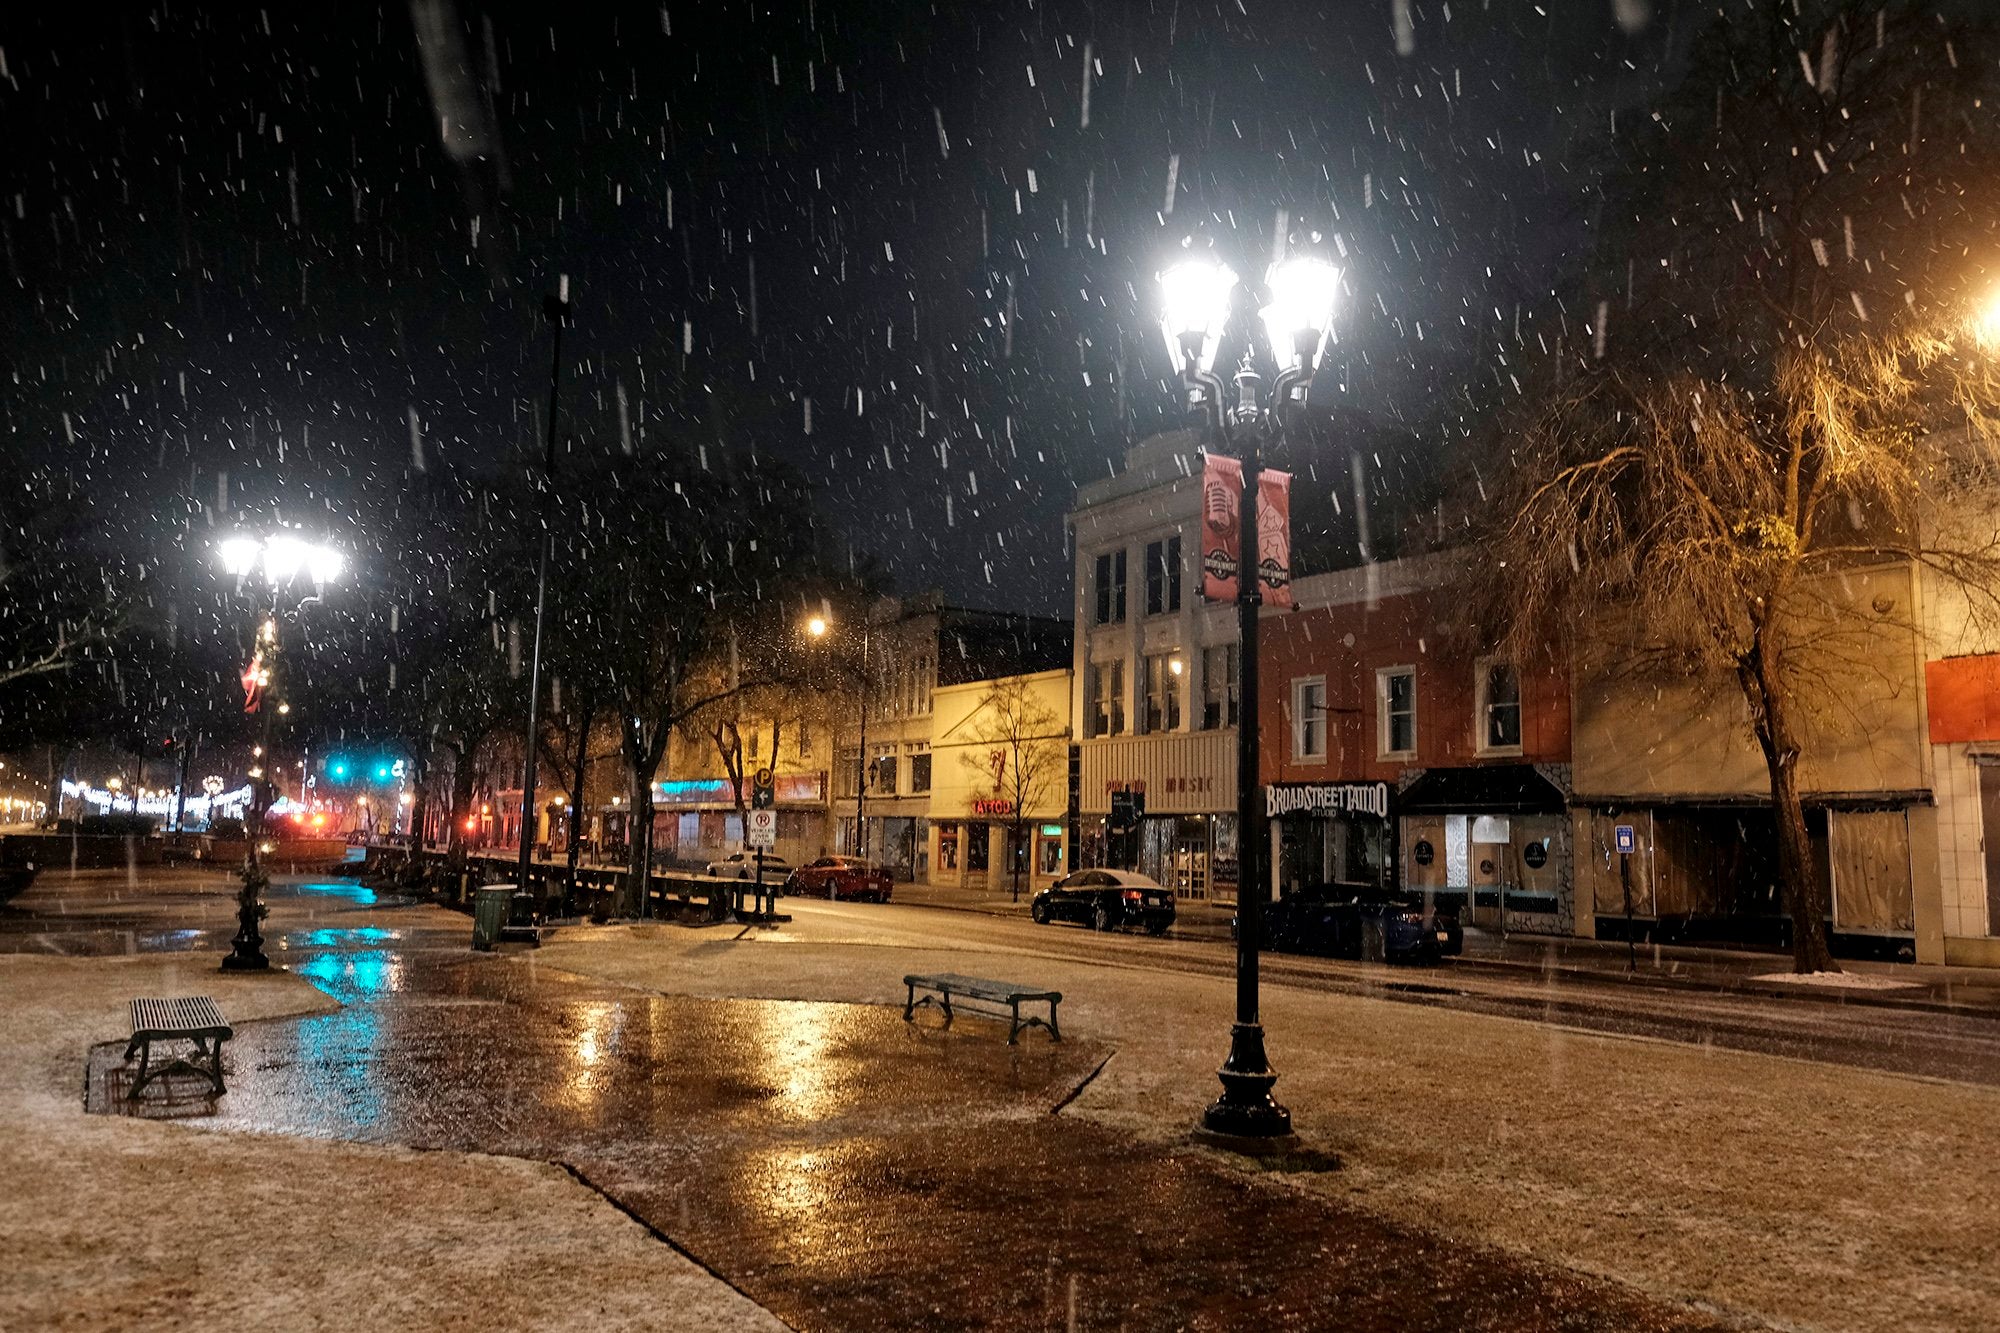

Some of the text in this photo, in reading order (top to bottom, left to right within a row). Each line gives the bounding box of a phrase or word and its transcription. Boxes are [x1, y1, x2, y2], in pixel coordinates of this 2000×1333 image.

[761, 770, 770, 784] P
[1165, 777, 1213, 793] MUSIC
[1266, 782, 1388, 818] BROAD STREET TATTOO
[1312, 808, 1337, 818] STUDIO
